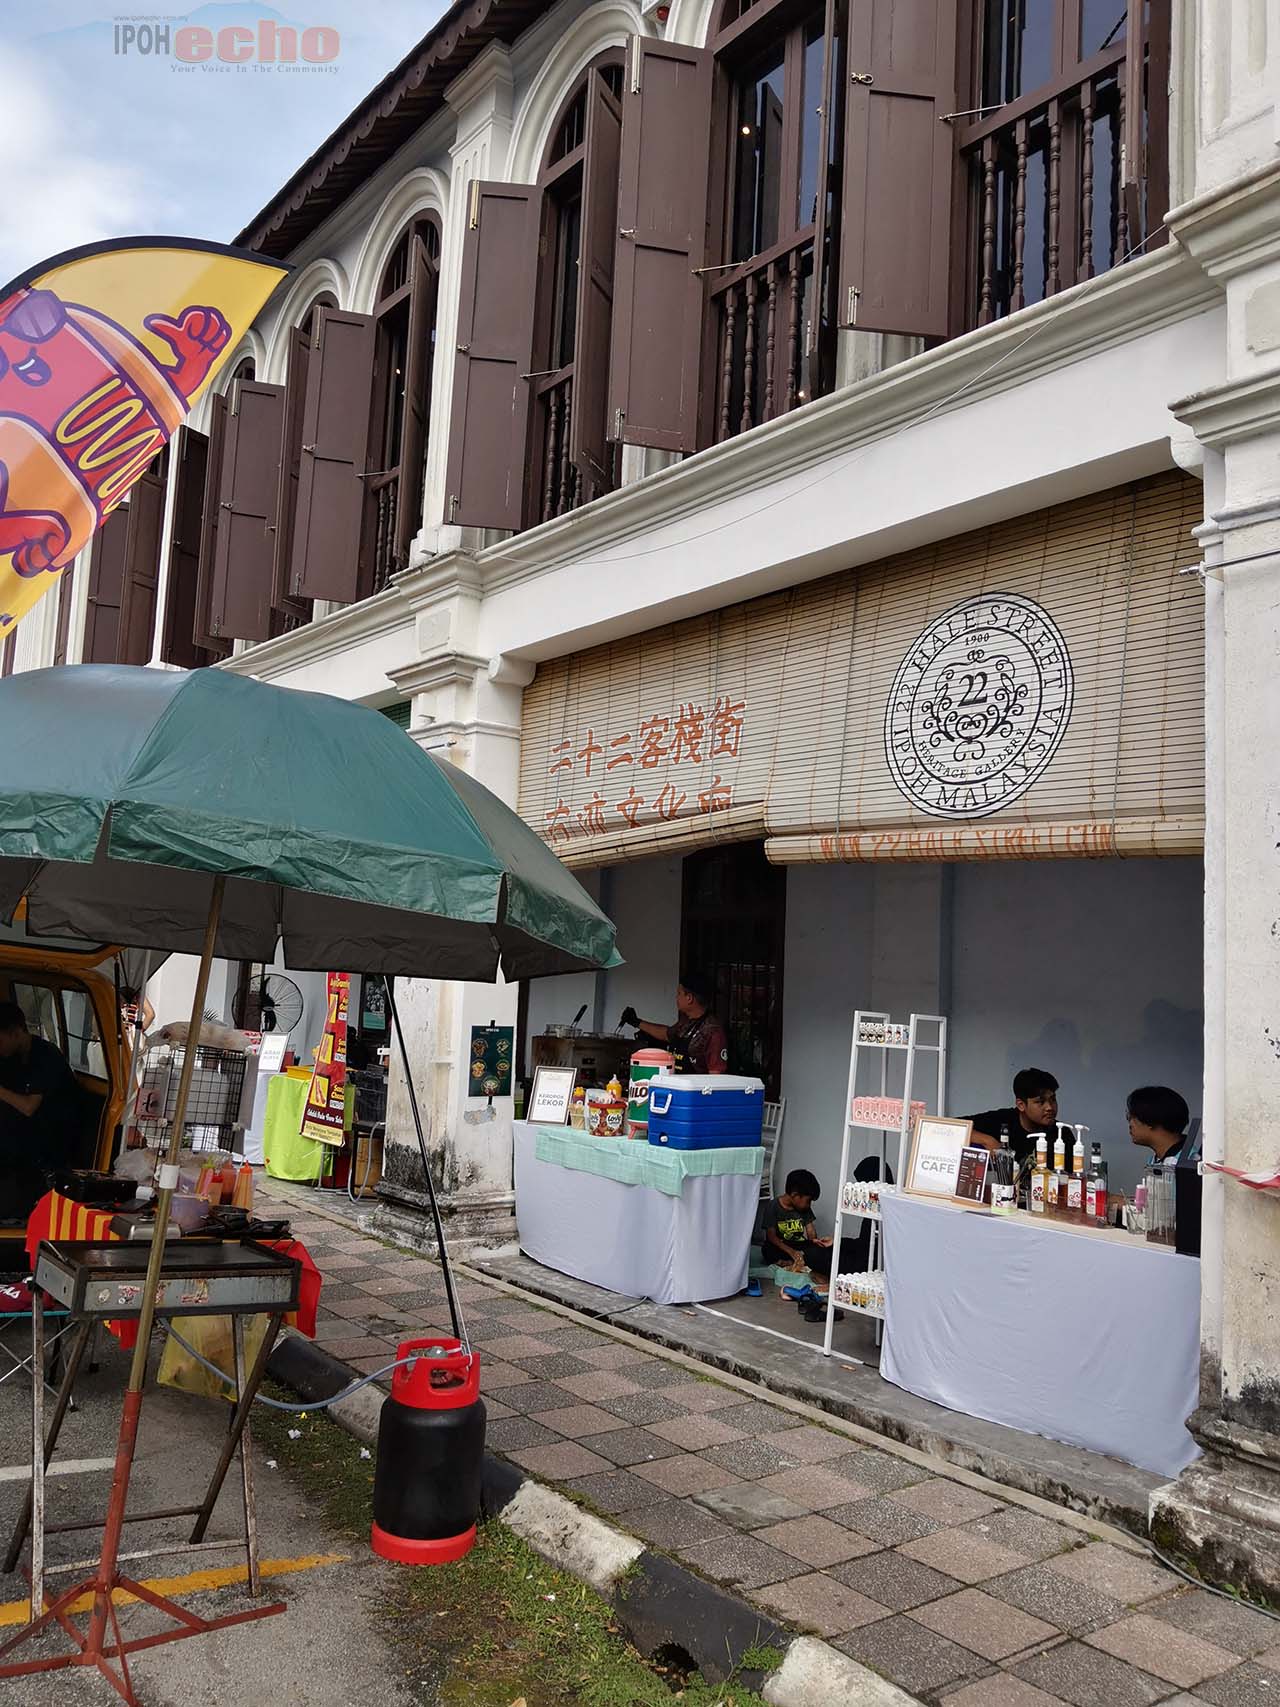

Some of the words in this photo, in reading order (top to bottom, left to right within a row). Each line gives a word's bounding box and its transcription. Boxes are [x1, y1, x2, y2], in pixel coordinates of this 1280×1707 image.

[964, 632, 990, 647] 1900
[896, 682, 916, 714] 22
[912, 608, 978, 674] HALE
[987, 604, 1065, 690] STREET
[957, 671, 989, 708] 22
[893, 728, 934, 796] IPOH
[935, 704, 1064, 809] MALAYSIA
[917, 739, 968, 779] HERITAGE
[974, 727, 1027, 777] GALLERY
[537, 1098, 564, 1107] LEKOR
[921, 1160, 955, 1175] CAFE
